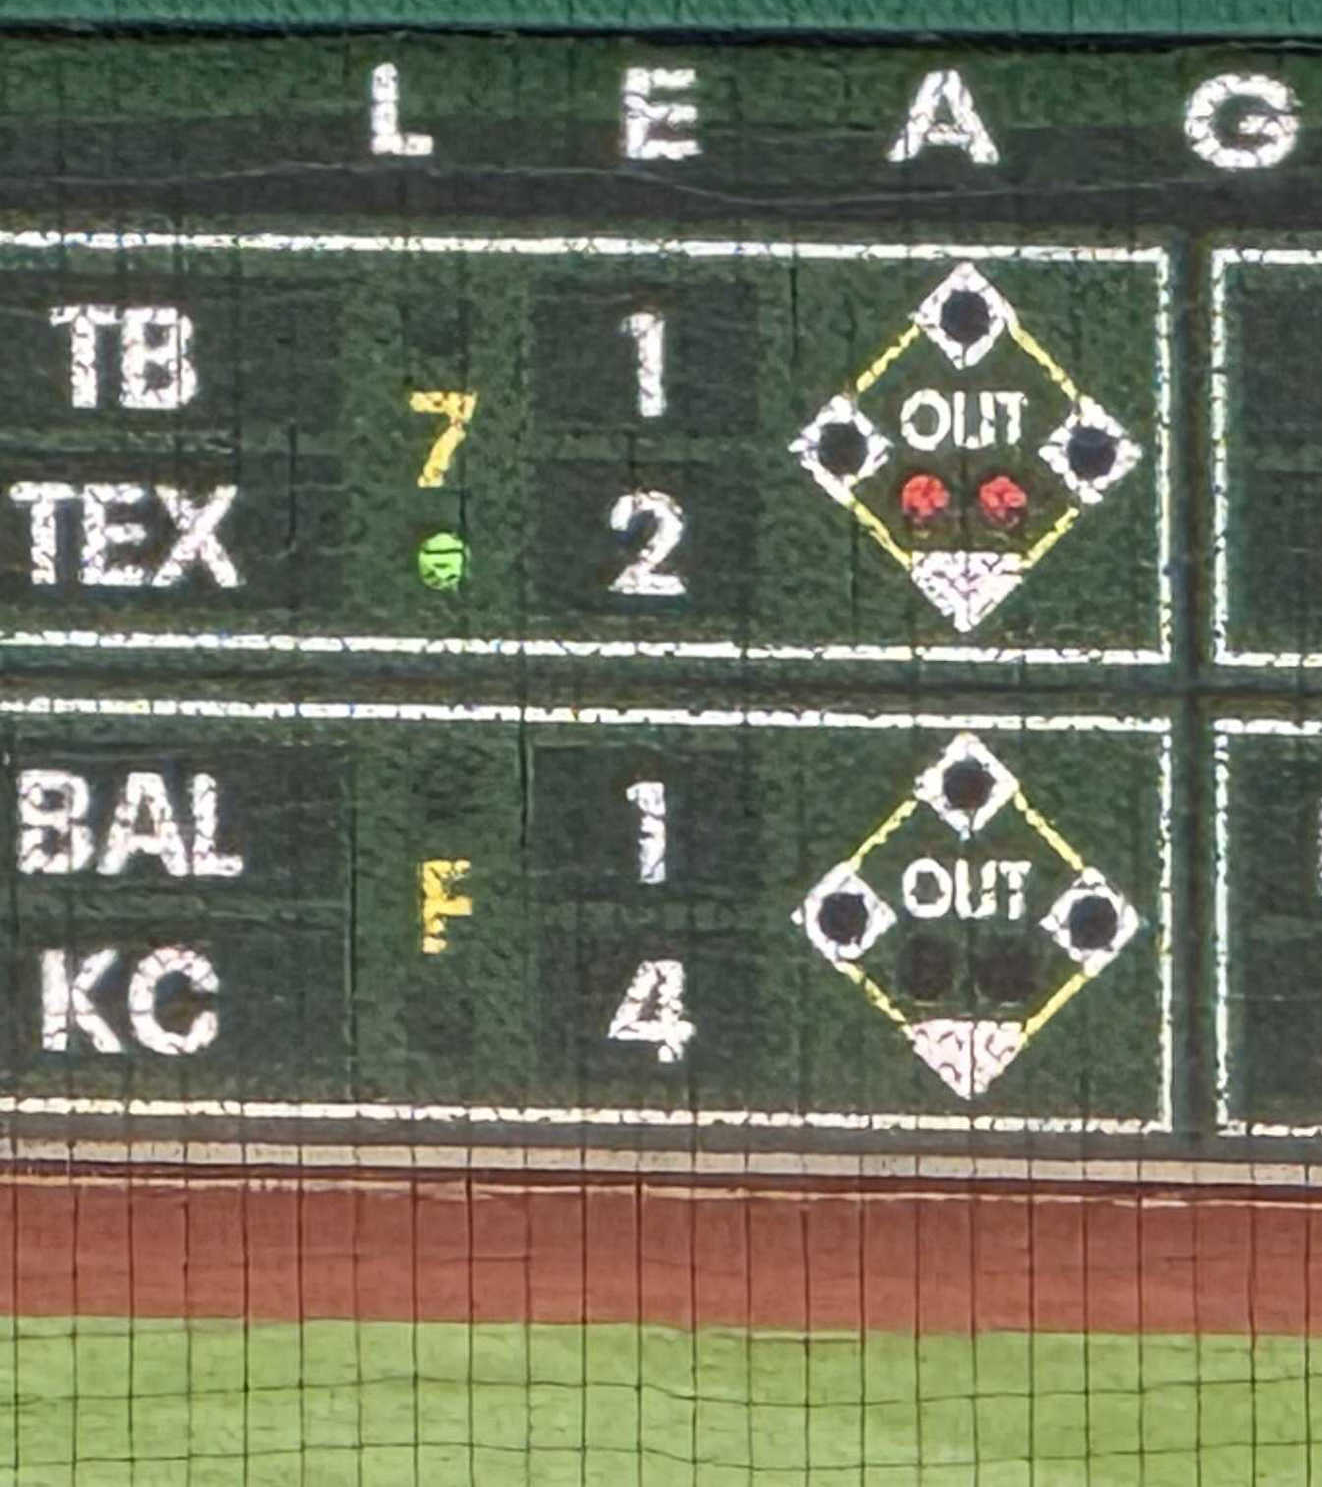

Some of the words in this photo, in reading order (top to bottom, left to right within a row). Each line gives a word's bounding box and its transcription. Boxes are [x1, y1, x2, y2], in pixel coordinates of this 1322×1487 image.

[49, 305, 197, 409] TB
[620, 312, 667, 418] 1
[409, 391, 477, 487] 7
[900, 388, 1029, 451] OUT
[9, 481, 244, 588] TEX
[609, 490, 687, 595] 2
[16, 769, 243, 876] BAL
[625, 781, 667, 884] 1
[416, 859, 472, 955] F
[902, 858, 1032, 920] OUT
[39, 946, 221, 1055] KC
[608, 960, 697, 1063] 4
